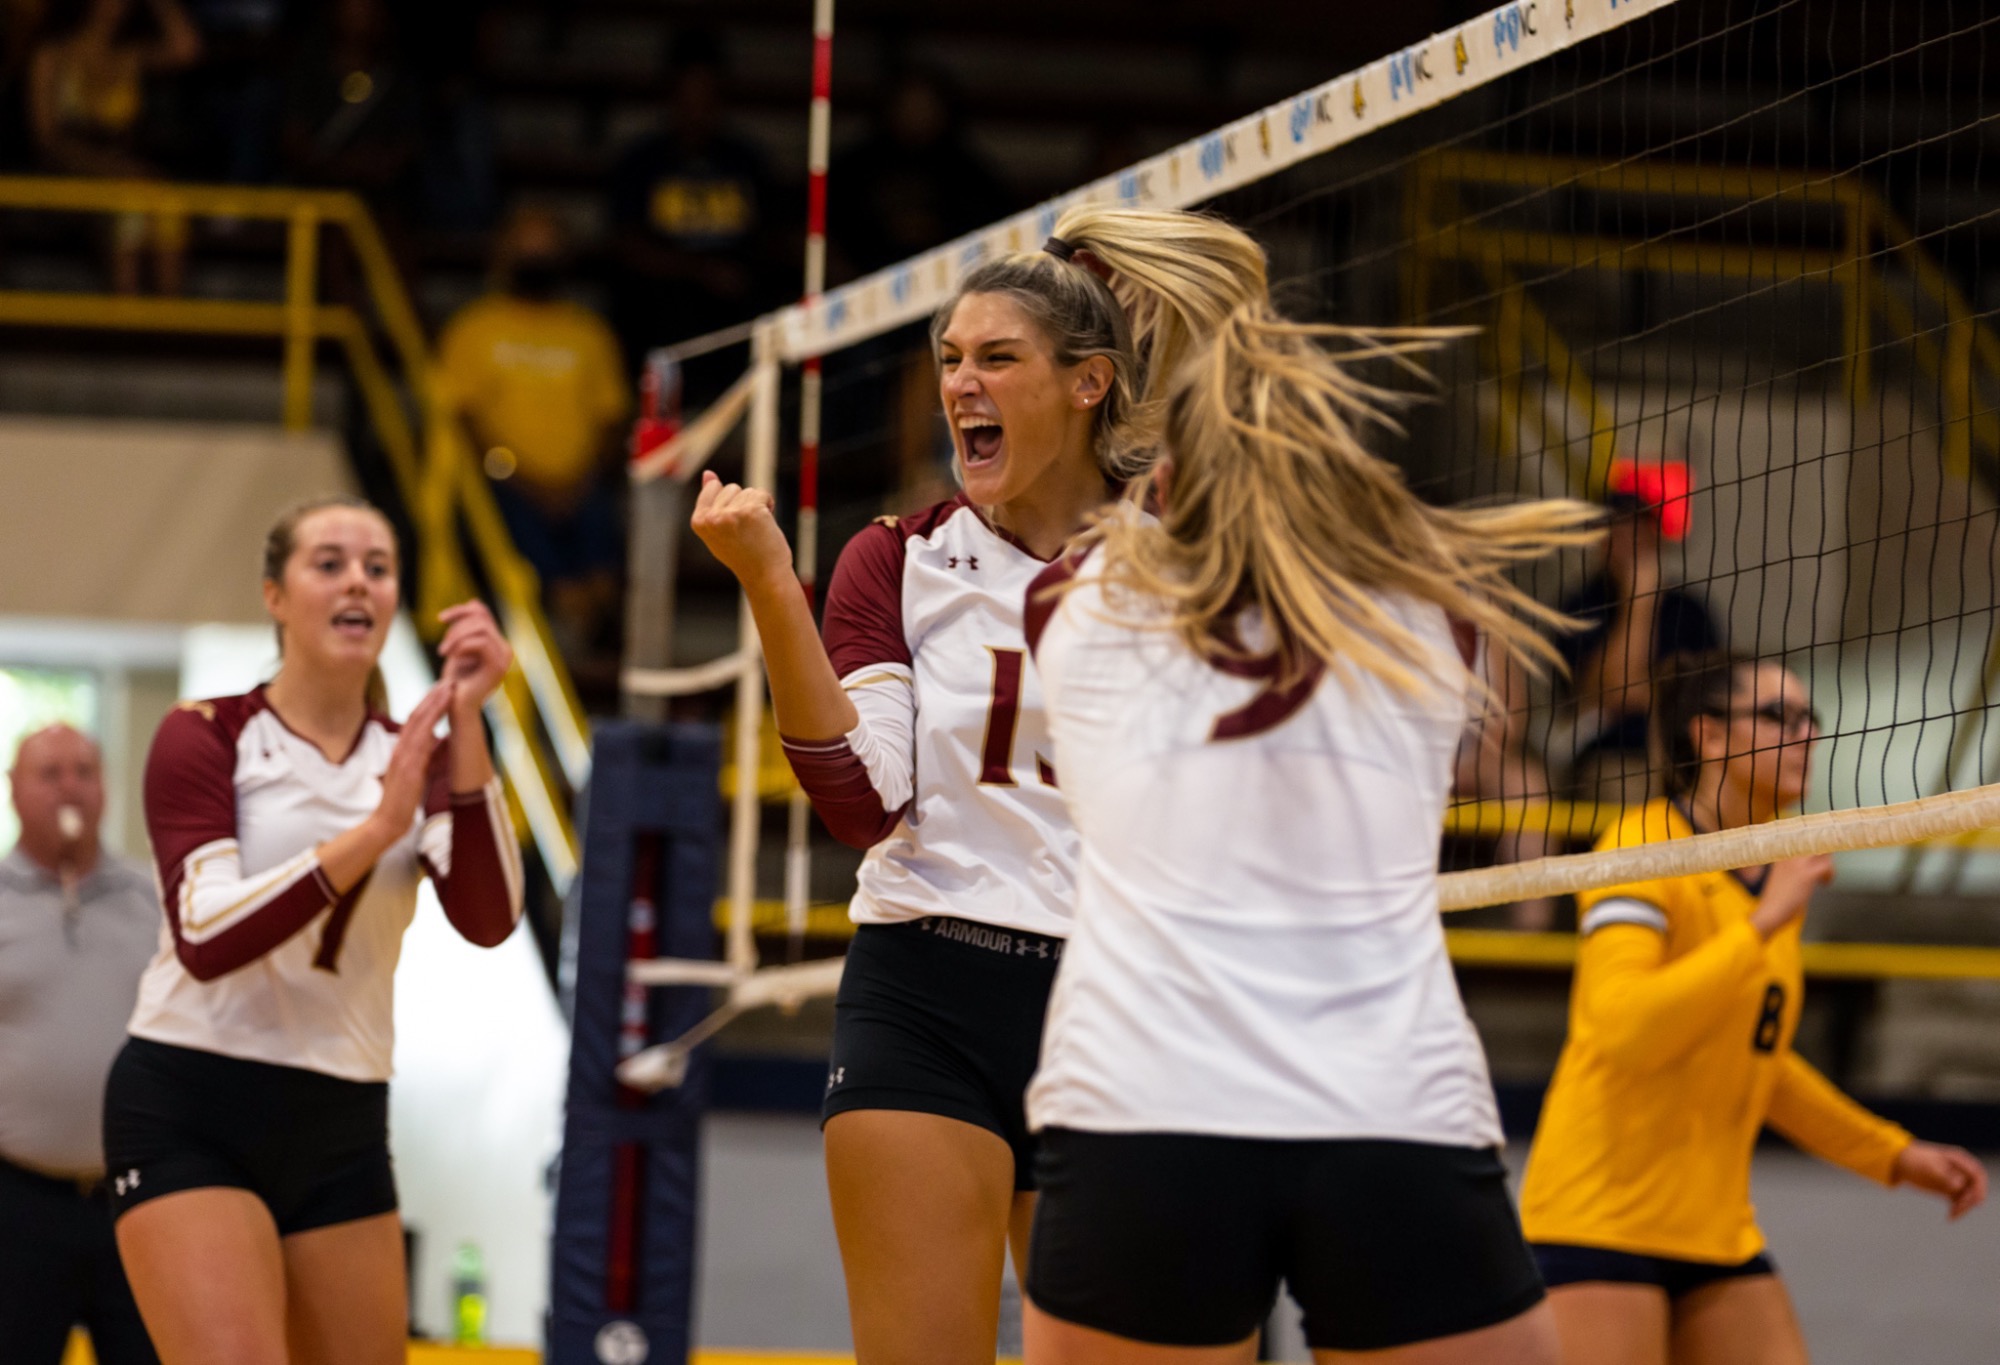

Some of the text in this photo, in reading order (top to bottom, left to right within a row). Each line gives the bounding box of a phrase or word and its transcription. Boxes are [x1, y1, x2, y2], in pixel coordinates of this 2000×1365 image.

[976, 644, 1062, 790] 1
[934, 918, 1012, 955] ARMOUR
[1753, 983, 1785, 1055] 8
